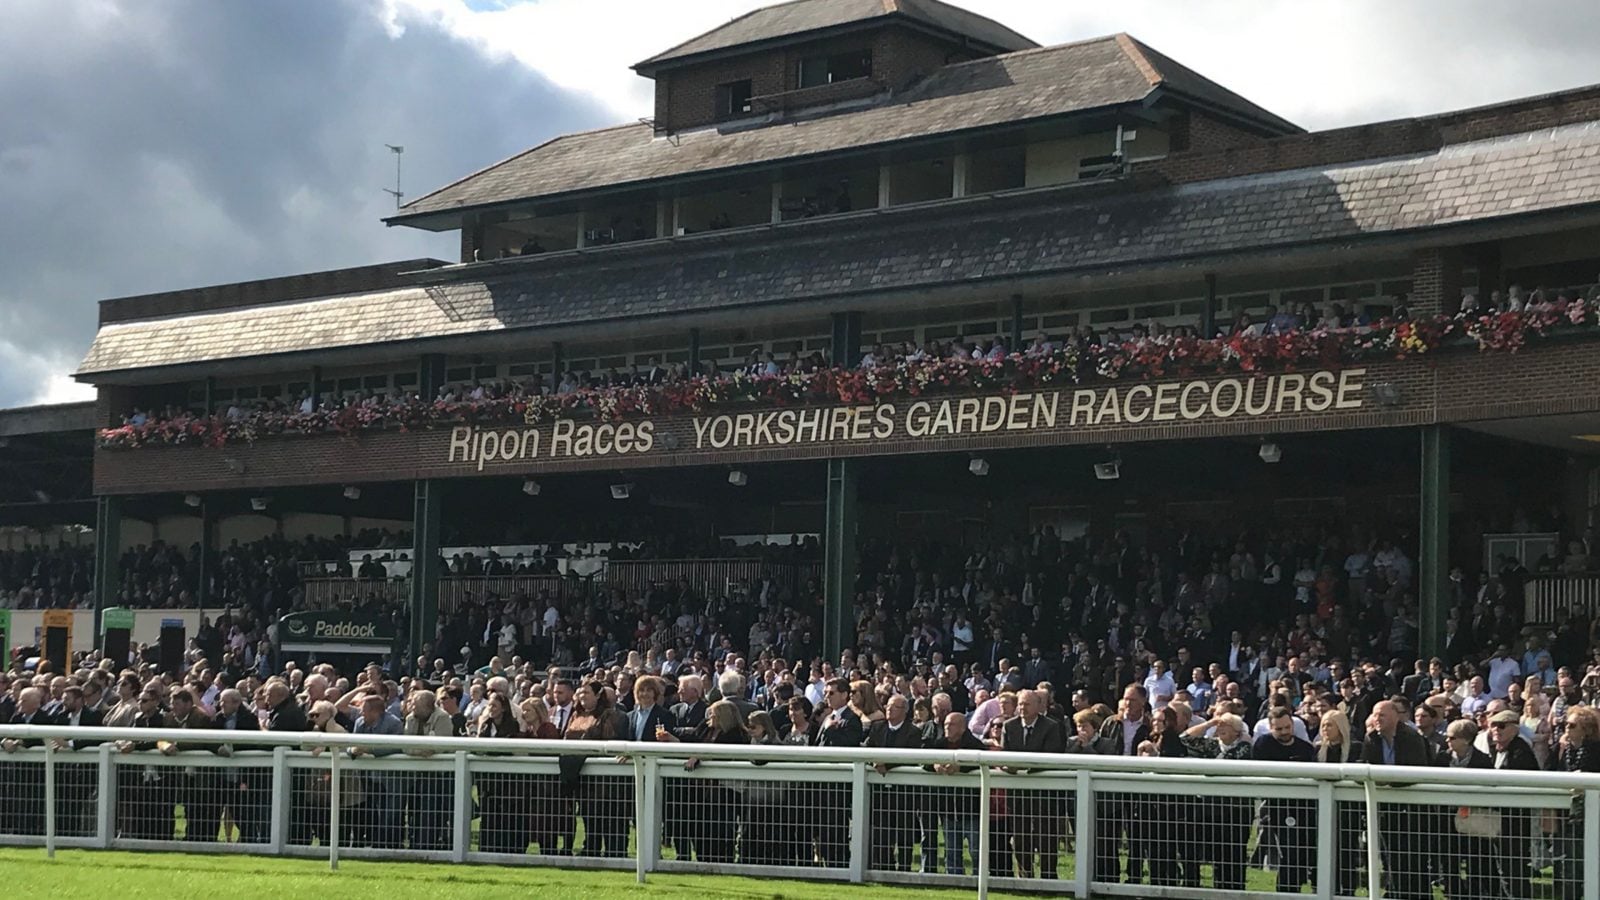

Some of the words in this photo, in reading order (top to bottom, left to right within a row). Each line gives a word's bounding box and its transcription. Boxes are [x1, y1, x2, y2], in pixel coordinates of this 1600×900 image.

[449, 426, 539, 471] Ripon
[550, 420, 654, 457] Races
[693, 397, 896, 449] YORKSHIRE'S
[905, 392, 1059, 437] GARDEN
[1069, 368, 1367, 425] RACECOURSE
[315, 620, 376, 637] Paddock
